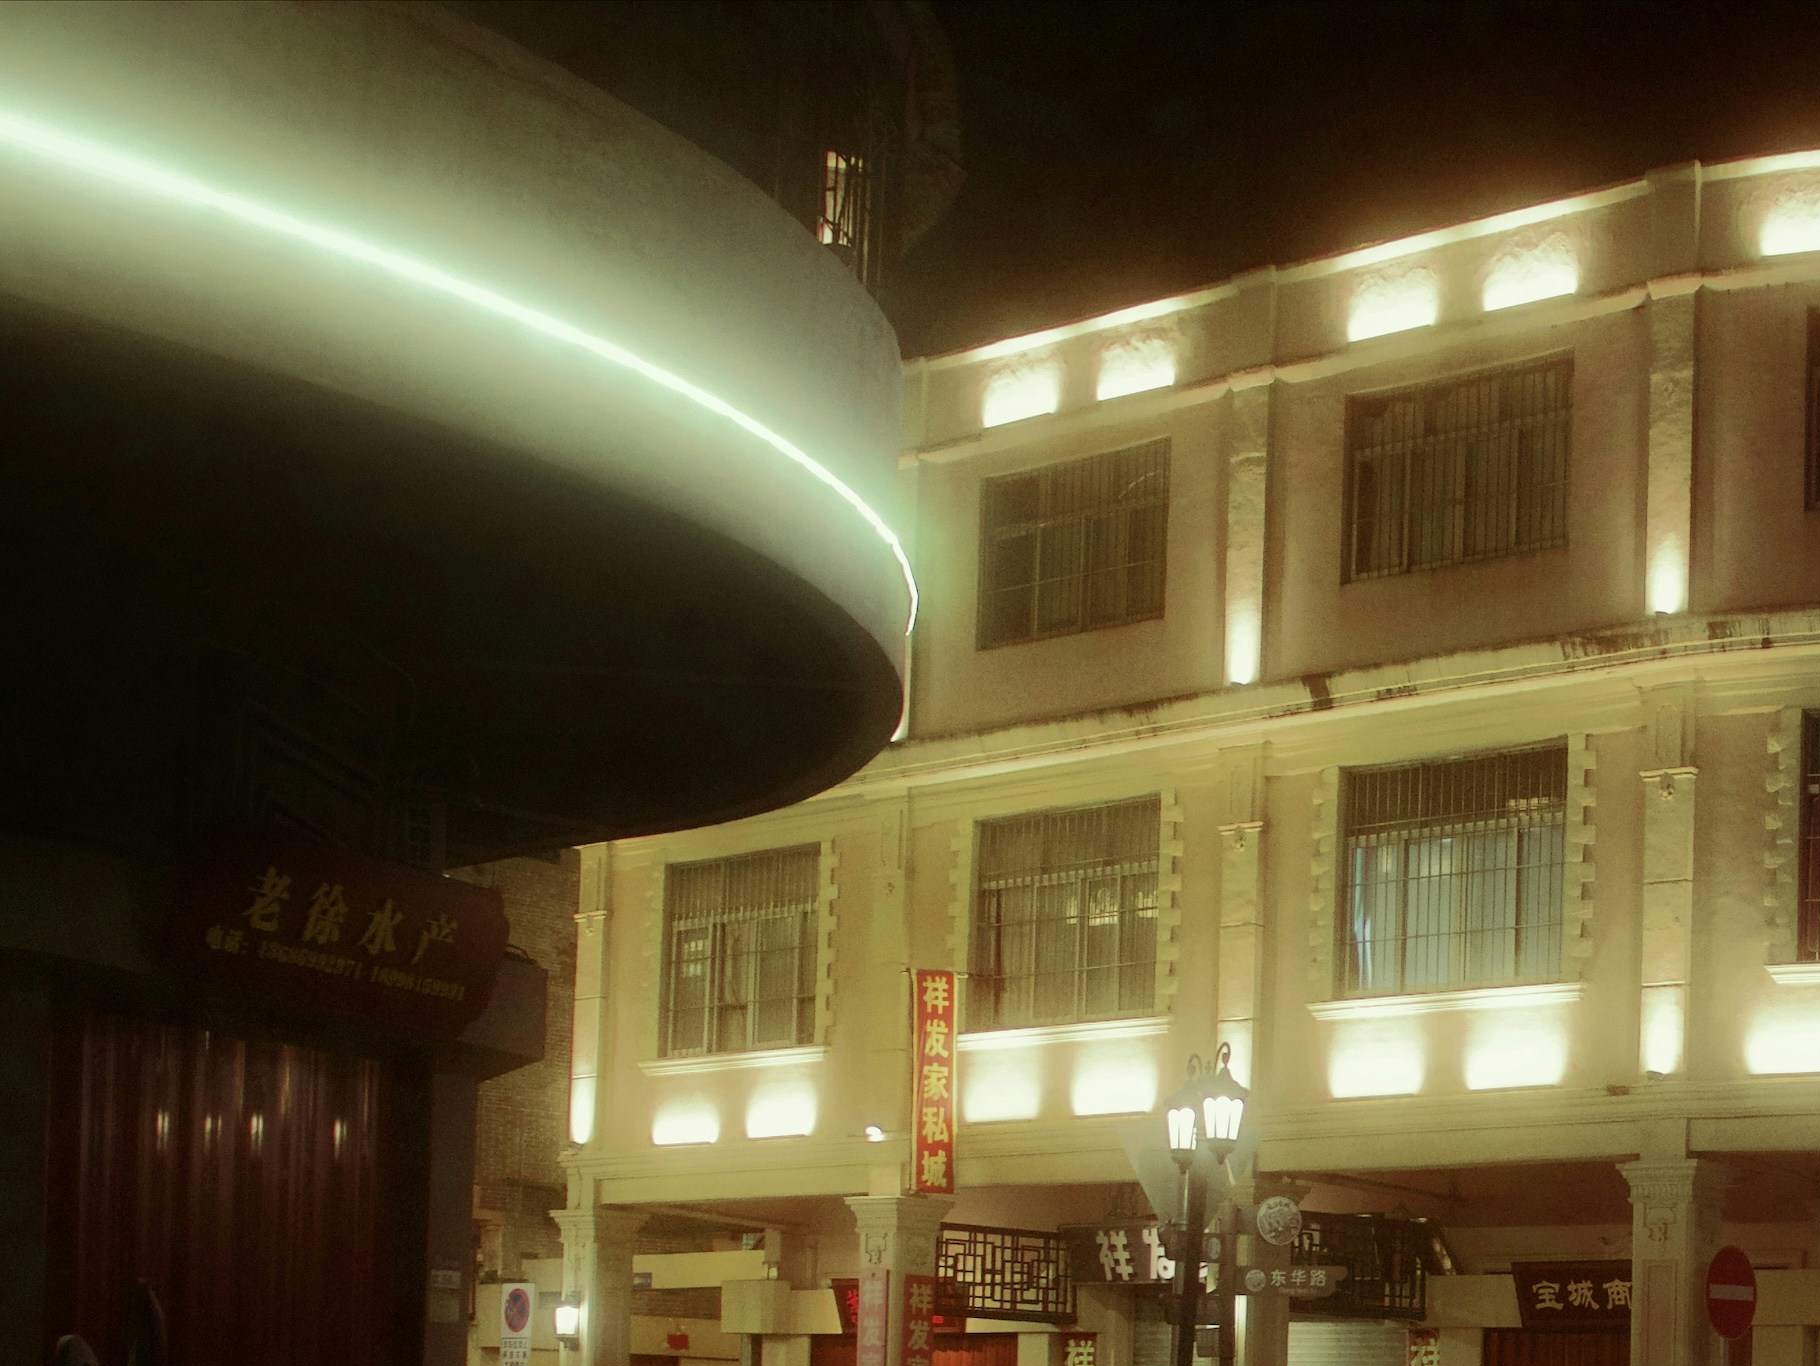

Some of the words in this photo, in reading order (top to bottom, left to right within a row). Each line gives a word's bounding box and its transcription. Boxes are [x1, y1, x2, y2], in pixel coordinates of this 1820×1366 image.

[243, 866, 460, 966] 老徐水产
[921, 975, 949, 1188] 祥发家私城
[1270, 1269, 1327, 1287] 东华路
